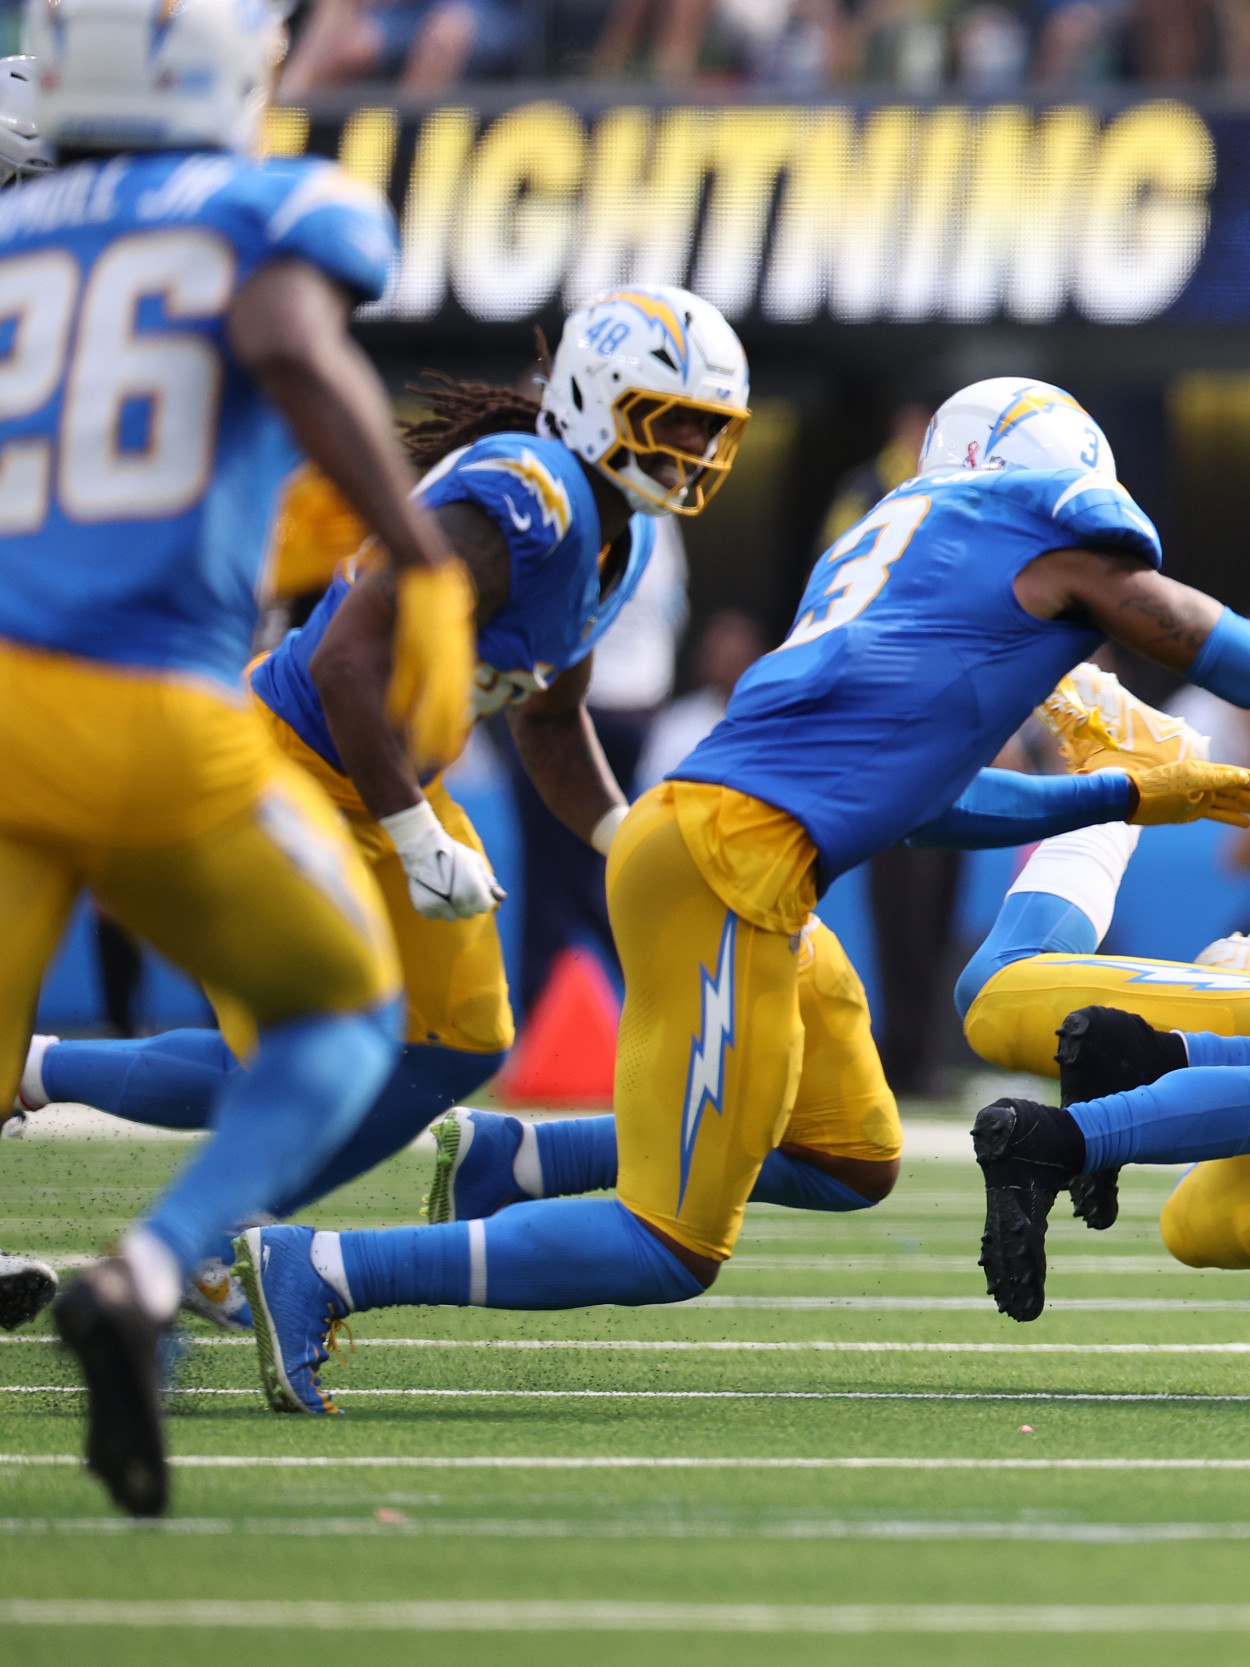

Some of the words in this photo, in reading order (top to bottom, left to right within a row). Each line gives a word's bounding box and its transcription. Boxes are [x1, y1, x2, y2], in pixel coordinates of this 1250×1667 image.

[586, 316, 631, 356] 48
[1080, 426, 1099, 469] 3
[766, 495, 932, 656] 3
